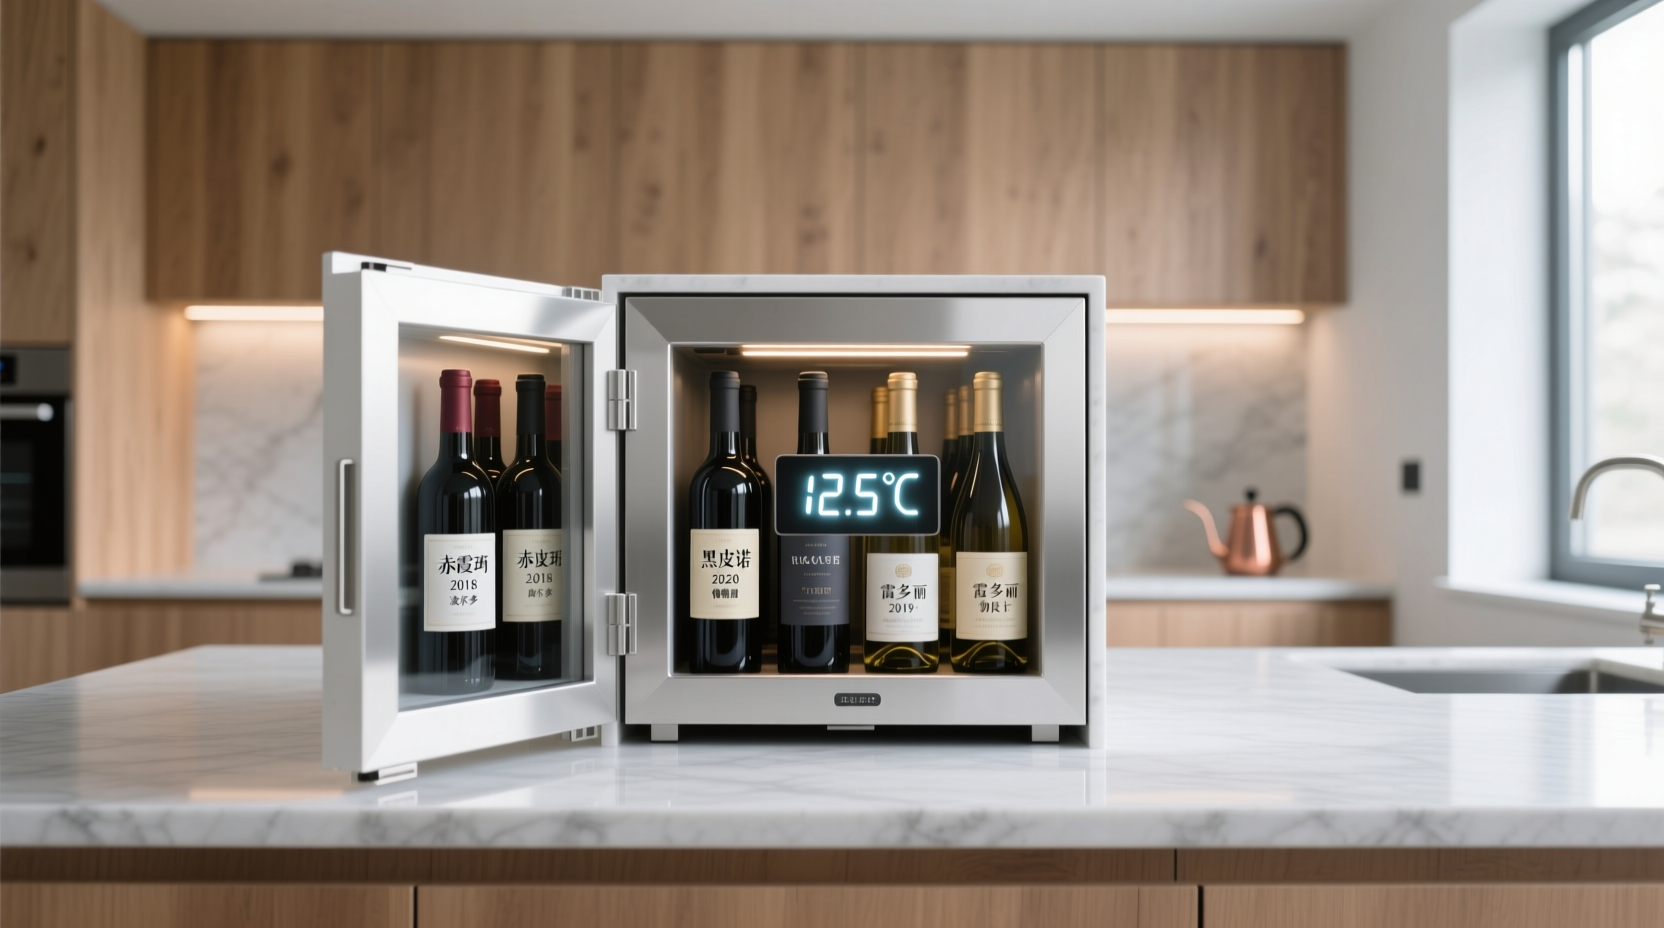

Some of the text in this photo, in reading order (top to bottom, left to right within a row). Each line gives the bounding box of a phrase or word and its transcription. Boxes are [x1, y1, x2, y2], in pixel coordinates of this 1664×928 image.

[805, 472, 919, 516] 12.5°C
[700, 549, 752, 569] 黑皮诺
[525, 573, 553, 584] 2018
[712, 574, 740, 585] 2020
[450, 579, 478, 591] 2018
[888, 603, 914, 613] 2019
